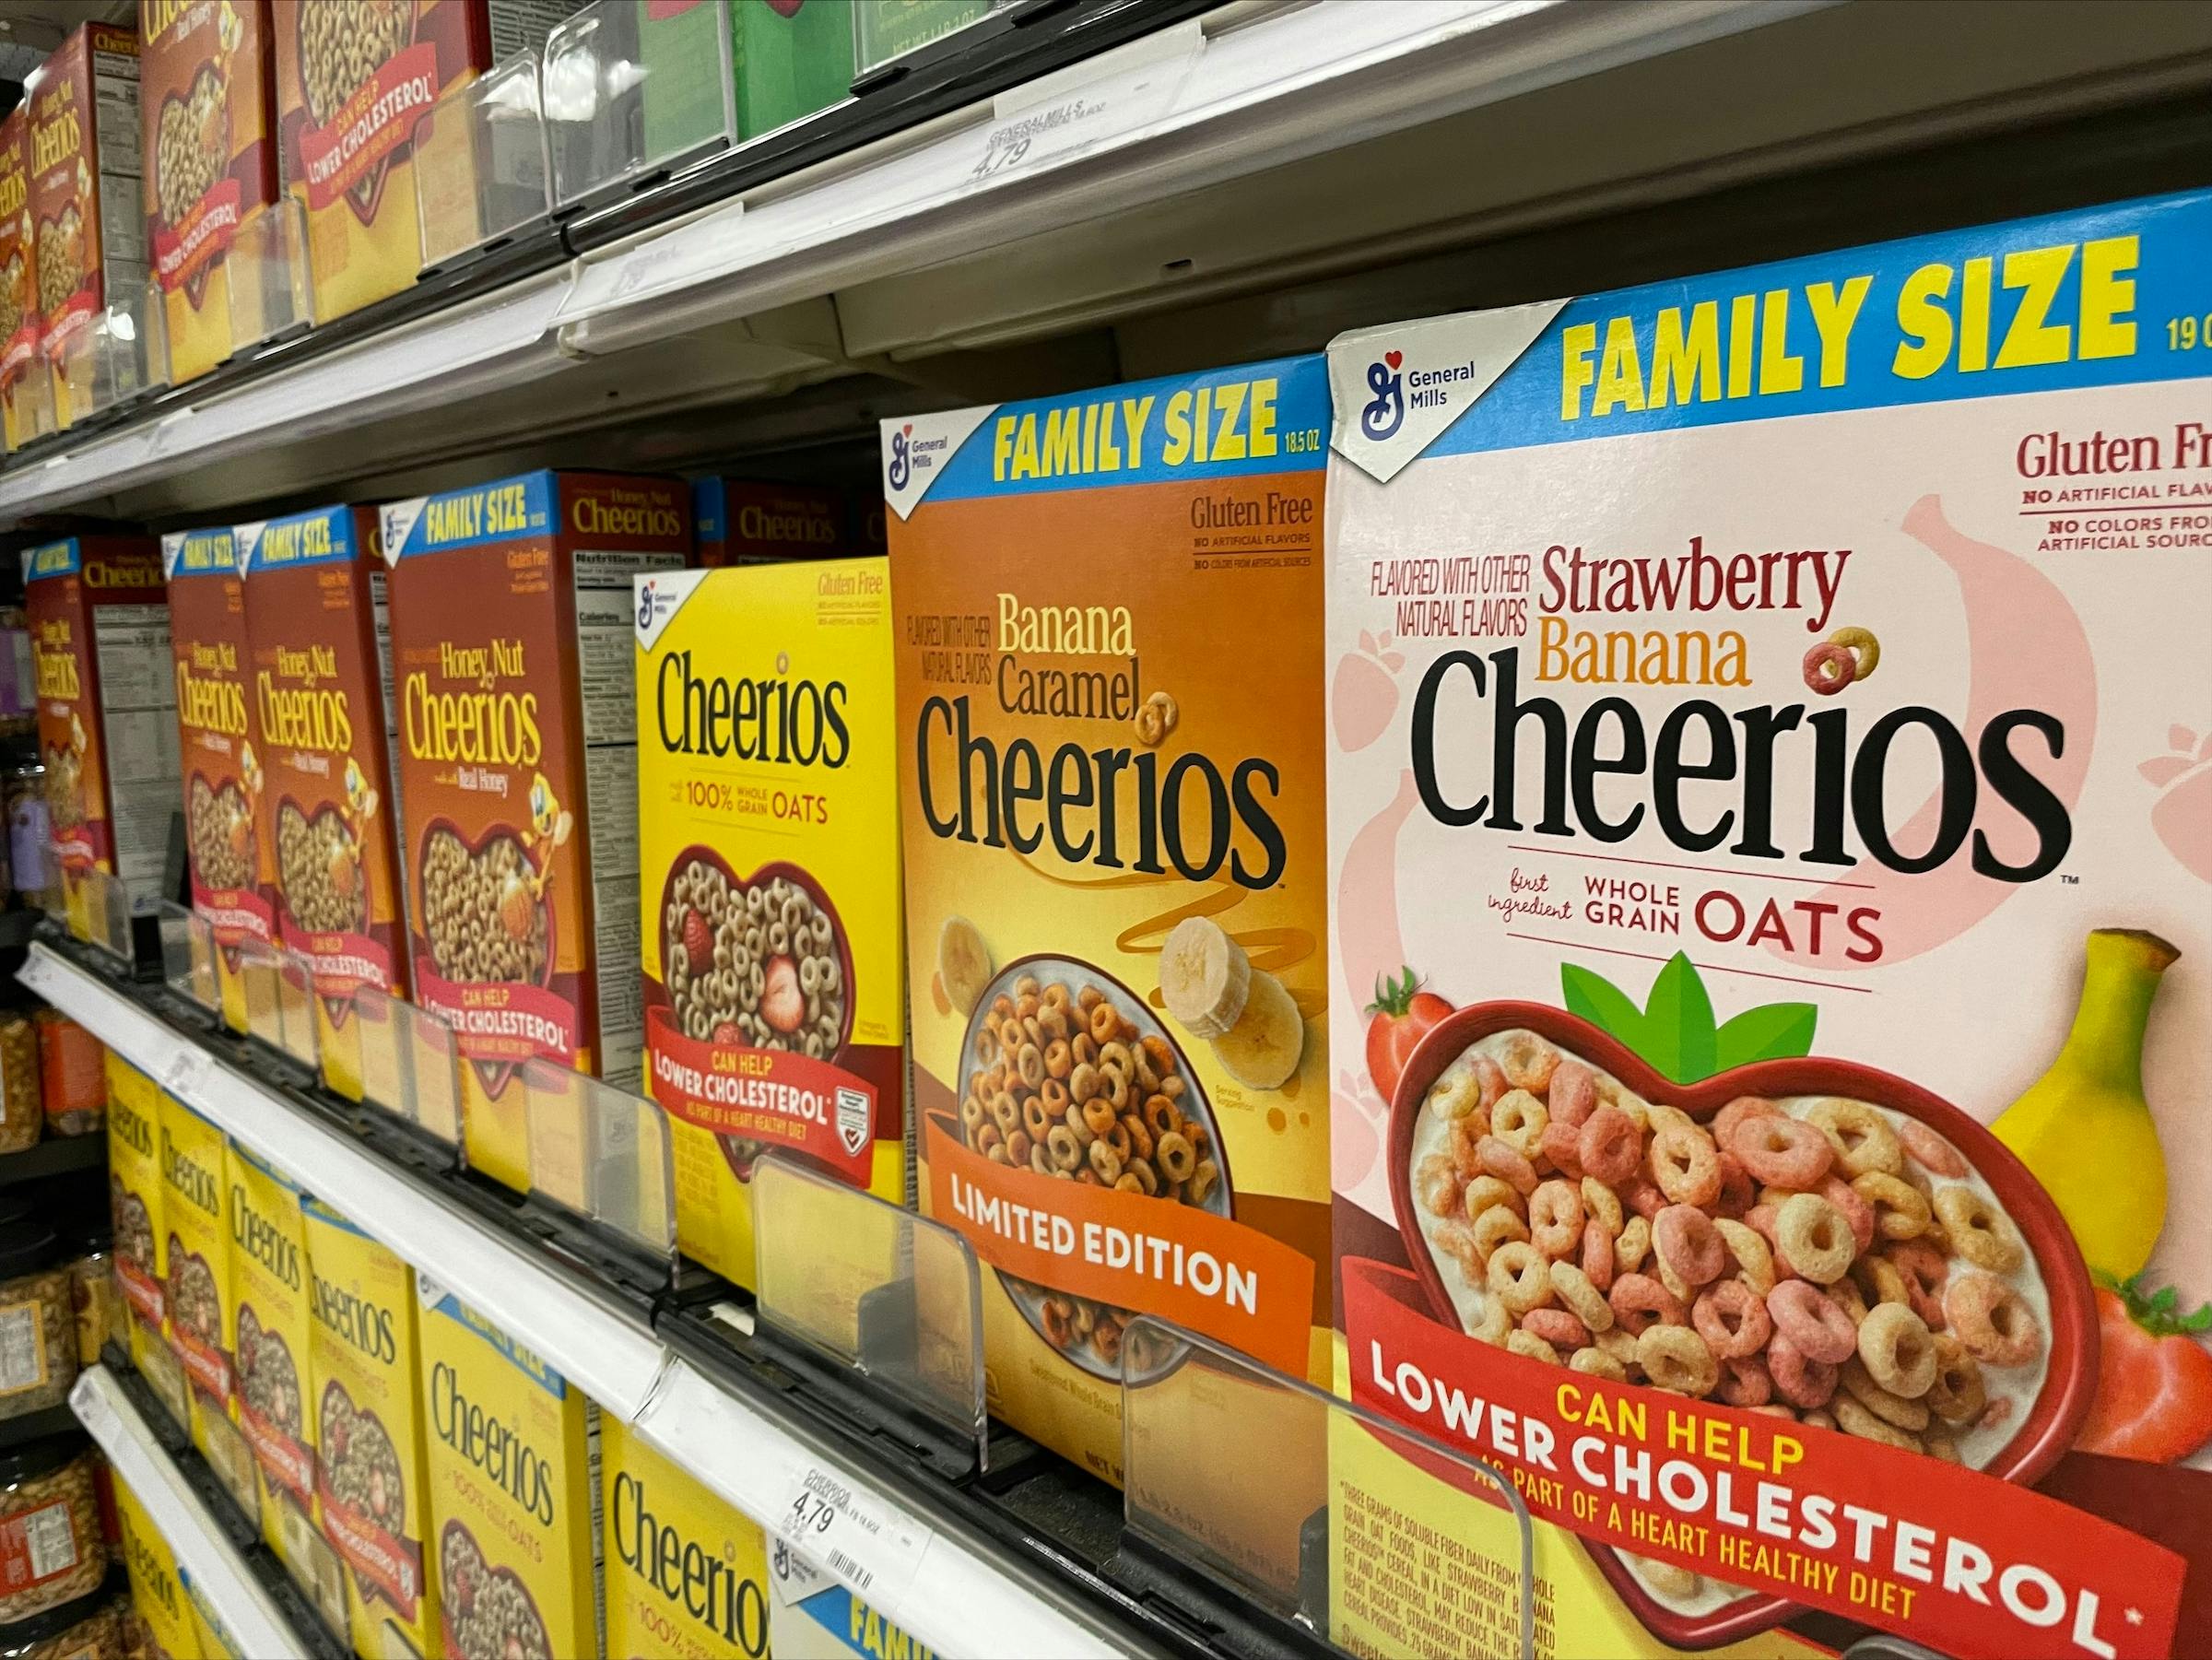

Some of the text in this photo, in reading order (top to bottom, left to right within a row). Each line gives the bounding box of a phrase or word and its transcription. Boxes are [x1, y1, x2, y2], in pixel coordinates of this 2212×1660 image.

[307, 146, 342, 184] LOWER
[972, 138, 1031, 175] 4.79
[1560, 234, 2199, 421] FAMILY SIZE 19
[1408, 360, 1475, 388] General
[1410, 389, 1447, 409] Mills
[912, 434, 947, 454] General
[993, 378, 1321, 482] FAMILY SIZE 18.5 OZ
[912, 454, 933, 470] Mills
[2017, 430, 2161, 478] Gluten
[427, 483, 526, 546] FAMILY SIZE
[1191, 492, 1313, 529] Gluten Free
[2022, 485, 2160, 504] NO ARTIFICIAL
[572, 497, 681, 536] Cheerios
[740, 505, 836, 543] Cheerios
[2048, 516, 2212, 534] NO COLORS FRO
[263, 516, 332, 562] FAMILY SIZE
[575, 553, 683, 566] Nutrition Facts
[1194, 533, 1311, 547] NO ARTIFICIAL FLAVORS
[2038, 534, 2212, 552] ARTIFICIAL SOURC
[818, 571, 884, 597] Gluten Free
[1371, 554, 1530, 597] FLAVORED WITH OTHER
[1538, 536, 1853, 634] Strawberry
[907, 615, 991, 648] FLAVORED WITH OTHER
[996, 594, 1136, 656] Banana
[1396, 598, 1528, 638] NATURAL FLAVORS
[311, 644, 337, 678] Nut
[441, 638, 525, 689] Honey Nut
[923, 652, 992, 686] NATURAL FLAVORS
[1535, 616, 1753, 687] Banana
[177, 659, 249, 736] Cheerios
[657, 649, 851, 770] Cheerios
[997, 654, 1140, 722] Caramel
[256, 669, 354, 753] Cheerios
[405, 670, 542, 768] Cheerios
[458, 765, 509, 799] Real Honey
[1410, 645, 2073, 885] Cheerios
[687, 781, 734, 813] 100%
[737, 785, 768, 801] WHOLE
[737, 799, 769, 816] GRAIN
[771, 790, 830, 825] OATS
[917, 695, 1288, 890] Cheerios
[1510, 866, 1549, 894] first
[1584, 876, 1680, 908] WHOLE
[1488, 892, 1573, 924] ingredient
[1584, 901, 1680, 936] GRAIN
[1694, 889, 1884, 963] OATS
[463, 988, 509, 1007] CAN HELP
[654, 1048, 703, 1098] LOWER
[712, 1051, 773, 1077] CAN HELP
[232, 1183, 300, 1292] Cheerios
[951, 1172, 1258, 1316] LIMITED EDITION
[1371, 1338, 1559, 1473] LOWER
[431, 1360, 554, 1527] Cheerios
[1557, 1383, 1805, 1475] CAN HELP
[793, 1491, 835, 1533] 4.79
[1367, 1495, 1555, 1604] GRAMS OF SOLUBLE FIBER DAILY FROM HOLE
[1371, 1519, 1383, 1541] OAT
[1423, 1548, 1441, 1574] LIKE
[1447, 1561, 1506, 1607] STRAWBERRY
[1512, 1466, 1917, 1620] PART OF A HEART HEALTHY DIET
[613, 1471, 772, 1659] Cheerio
[1421, 1571, 1430, 1592] IN
[1433, 1577, 1439, 1595] A
[1441, 1581, 1460, 1606] DIET
[1464, 1593, 1483, 1618] LOW
[1487, 1605, 1496, 1627] IN
[639, 1601, 685, 1656] 100%
[1406, 1607, 1462, 1653] STRAWBERRY
[1434, 1600, 1452, 1626] MAY
[1455, 1611, 1488, 1646] REDUCE
[1492, 1631, 1509, 1656] THE
